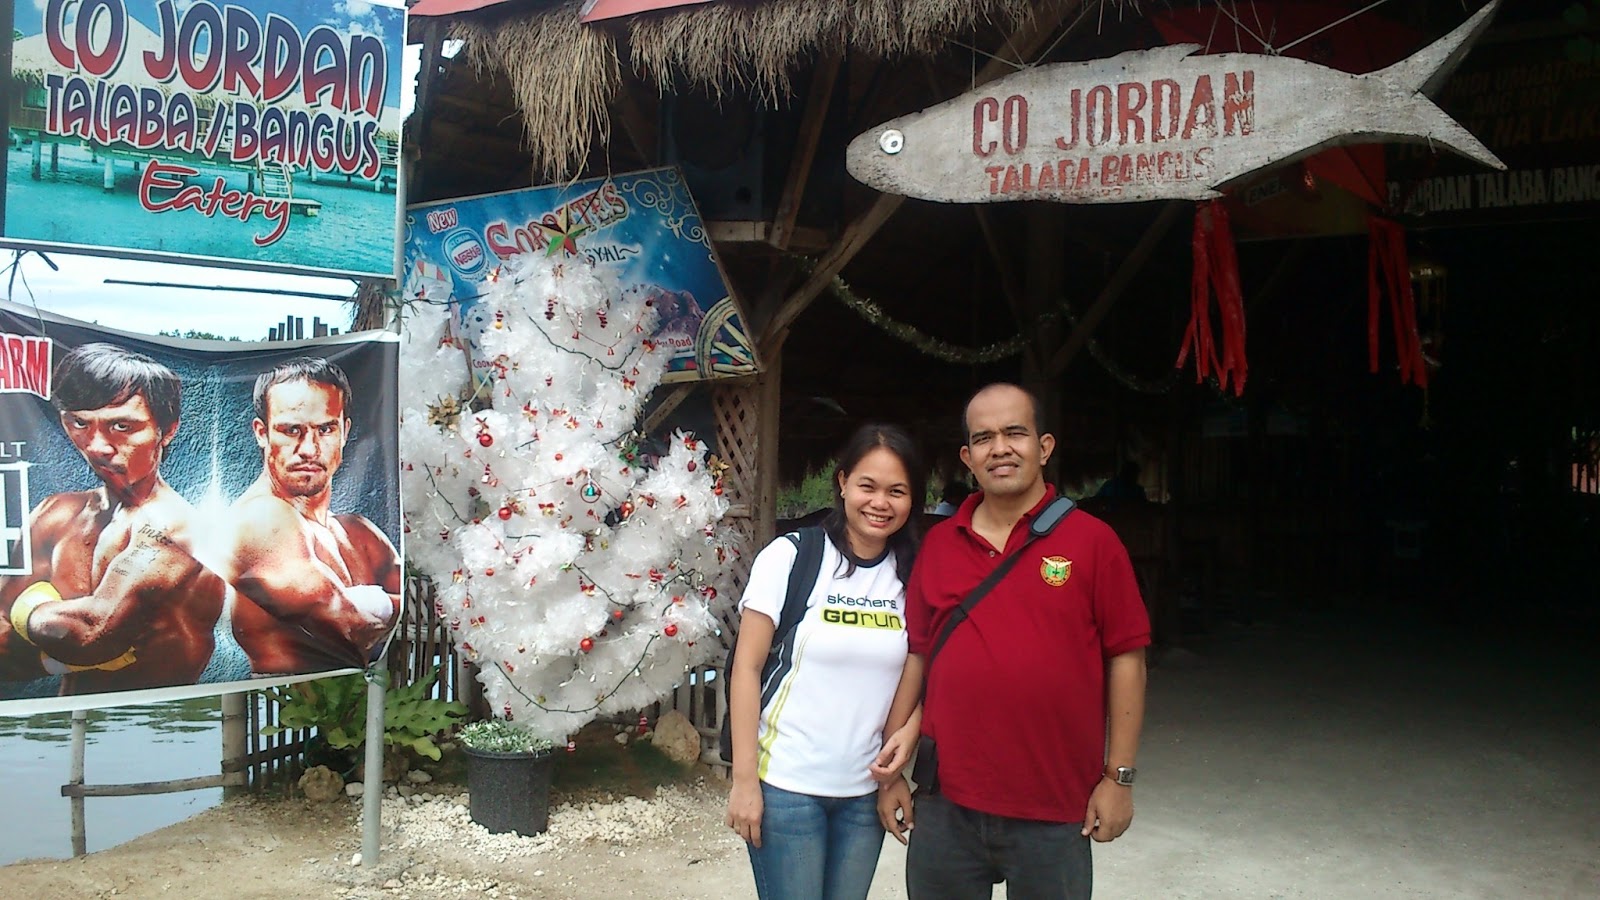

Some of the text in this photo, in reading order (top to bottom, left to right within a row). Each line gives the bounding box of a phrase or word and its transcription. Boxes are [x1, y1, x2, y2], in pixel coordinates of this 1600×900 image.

[46, 0, 387, 119] CO JORDAN
[973, 71, 1254, 157] CO JORDAN
[140, 160, 290, 246] Eatery
[427, 208, 457, 233] New
[827, 593, 898, 610] skechers
